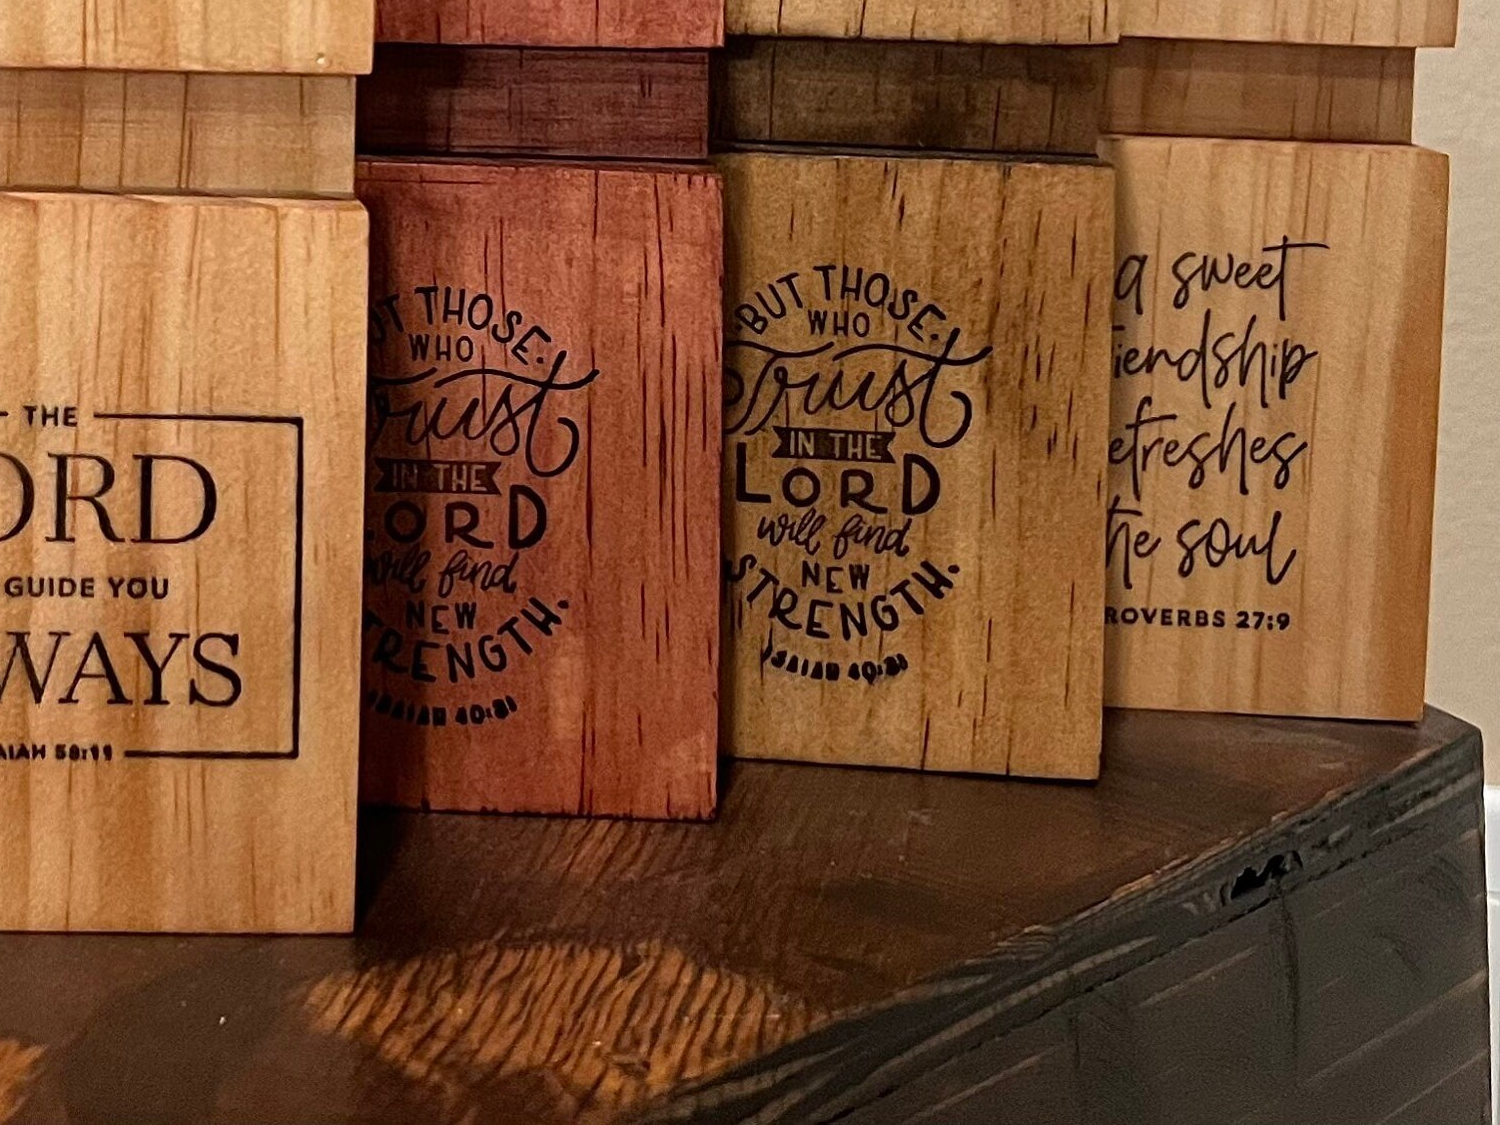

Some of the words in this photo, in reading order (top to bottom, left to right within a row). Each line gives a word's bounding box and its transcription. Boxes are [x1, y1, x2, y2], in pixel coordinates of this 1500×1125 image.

[1114, 253, 1148, 315] a
[1172, 235, 1330, 321] sweet
[408, 333, 474, 363] WHO
[808, 309, 870, 338] WHO
[1111, 308, 1319, 409] iendship
[723, 327, 993, 449] Trust
[22, 405, 78, 427] THE
[369, 350, 600, 478] rust
[789, 432, 815, 457] IN
[829, 433, 883, 460] THE
[1107, 396, 1308, 501] efreshes
[392, 462, 419, 490] IN
[432, 462, 489, 492] THE
[736, 441, 941, 516] LORD
[367, 484, 547, 550] ORD
[757, 509, 825, 556] will
[833, 513, 910, 560] find
[1105, 494, 1162, 590] he
[1177, 510, 1297, 586] soul
[4, 576, 96, 599] GUIDE
[108, 577, 169, 600] YOU
[437, 549, 519, 598] find
[802, 560, 870, 594] NEW
[406, 600, 477, 635] NEW
[1104, 607, 1225, 629] ROVERBS
[1235, 611, 1290, 631] 27:9
